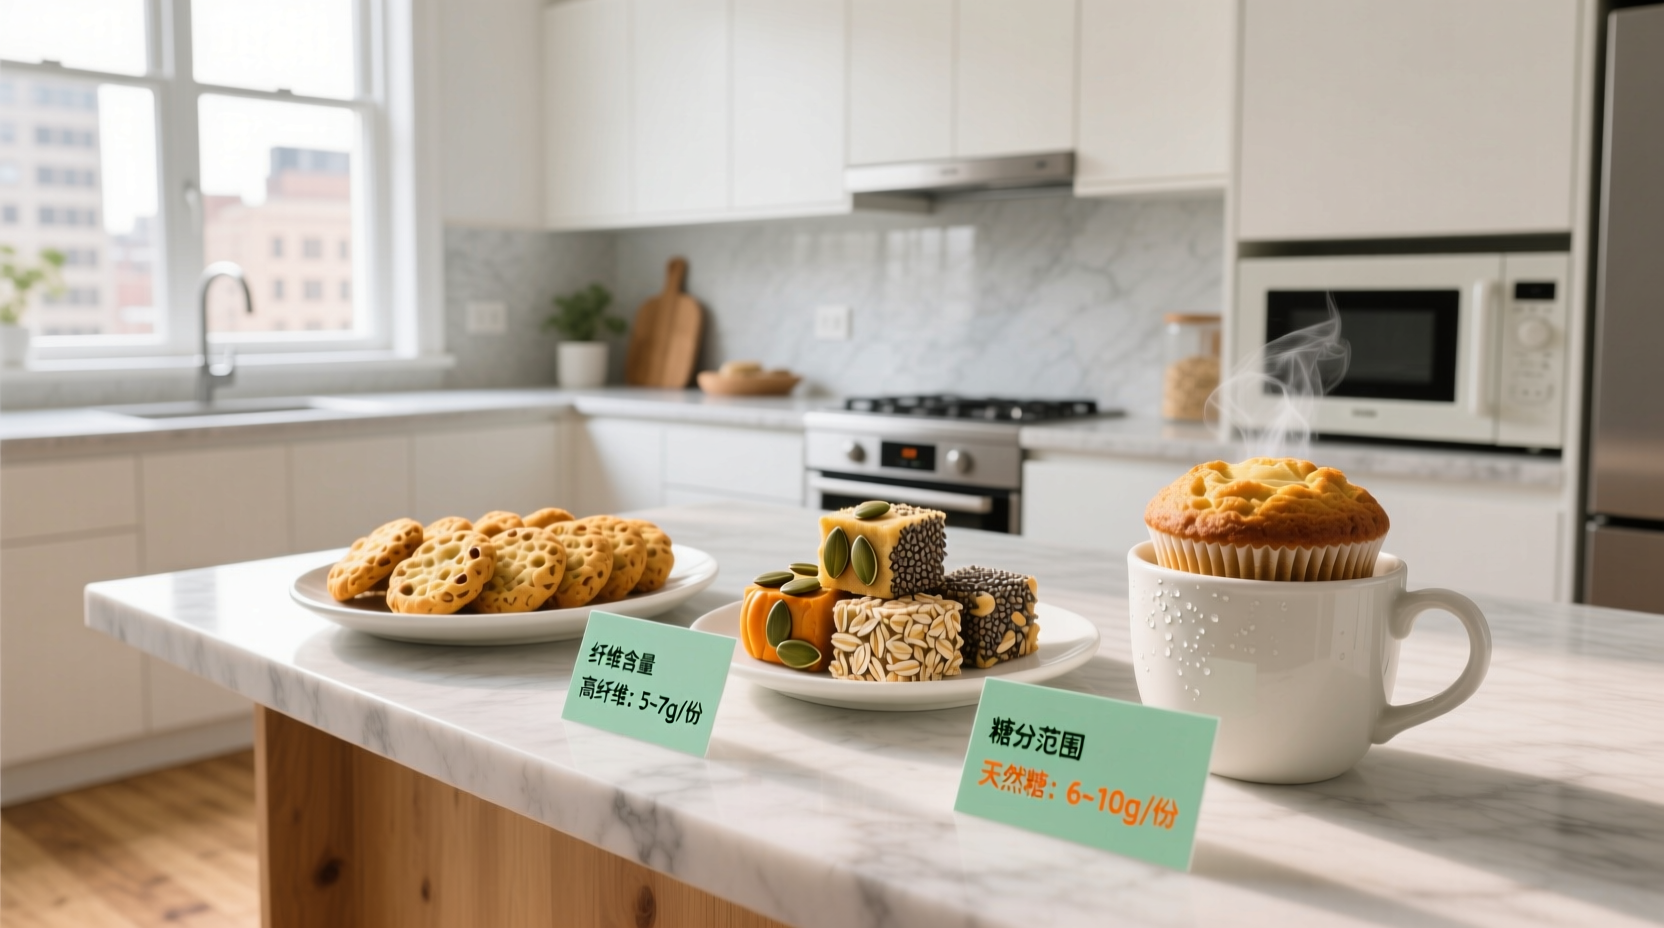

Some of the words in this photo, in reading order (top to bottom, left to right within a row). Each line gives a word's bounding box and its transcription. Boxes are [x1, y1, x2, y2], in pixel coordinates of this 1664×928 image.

[588, 641, 656, 676] 纤维含量
[988, 716, 1086, 762] 糖分范围
